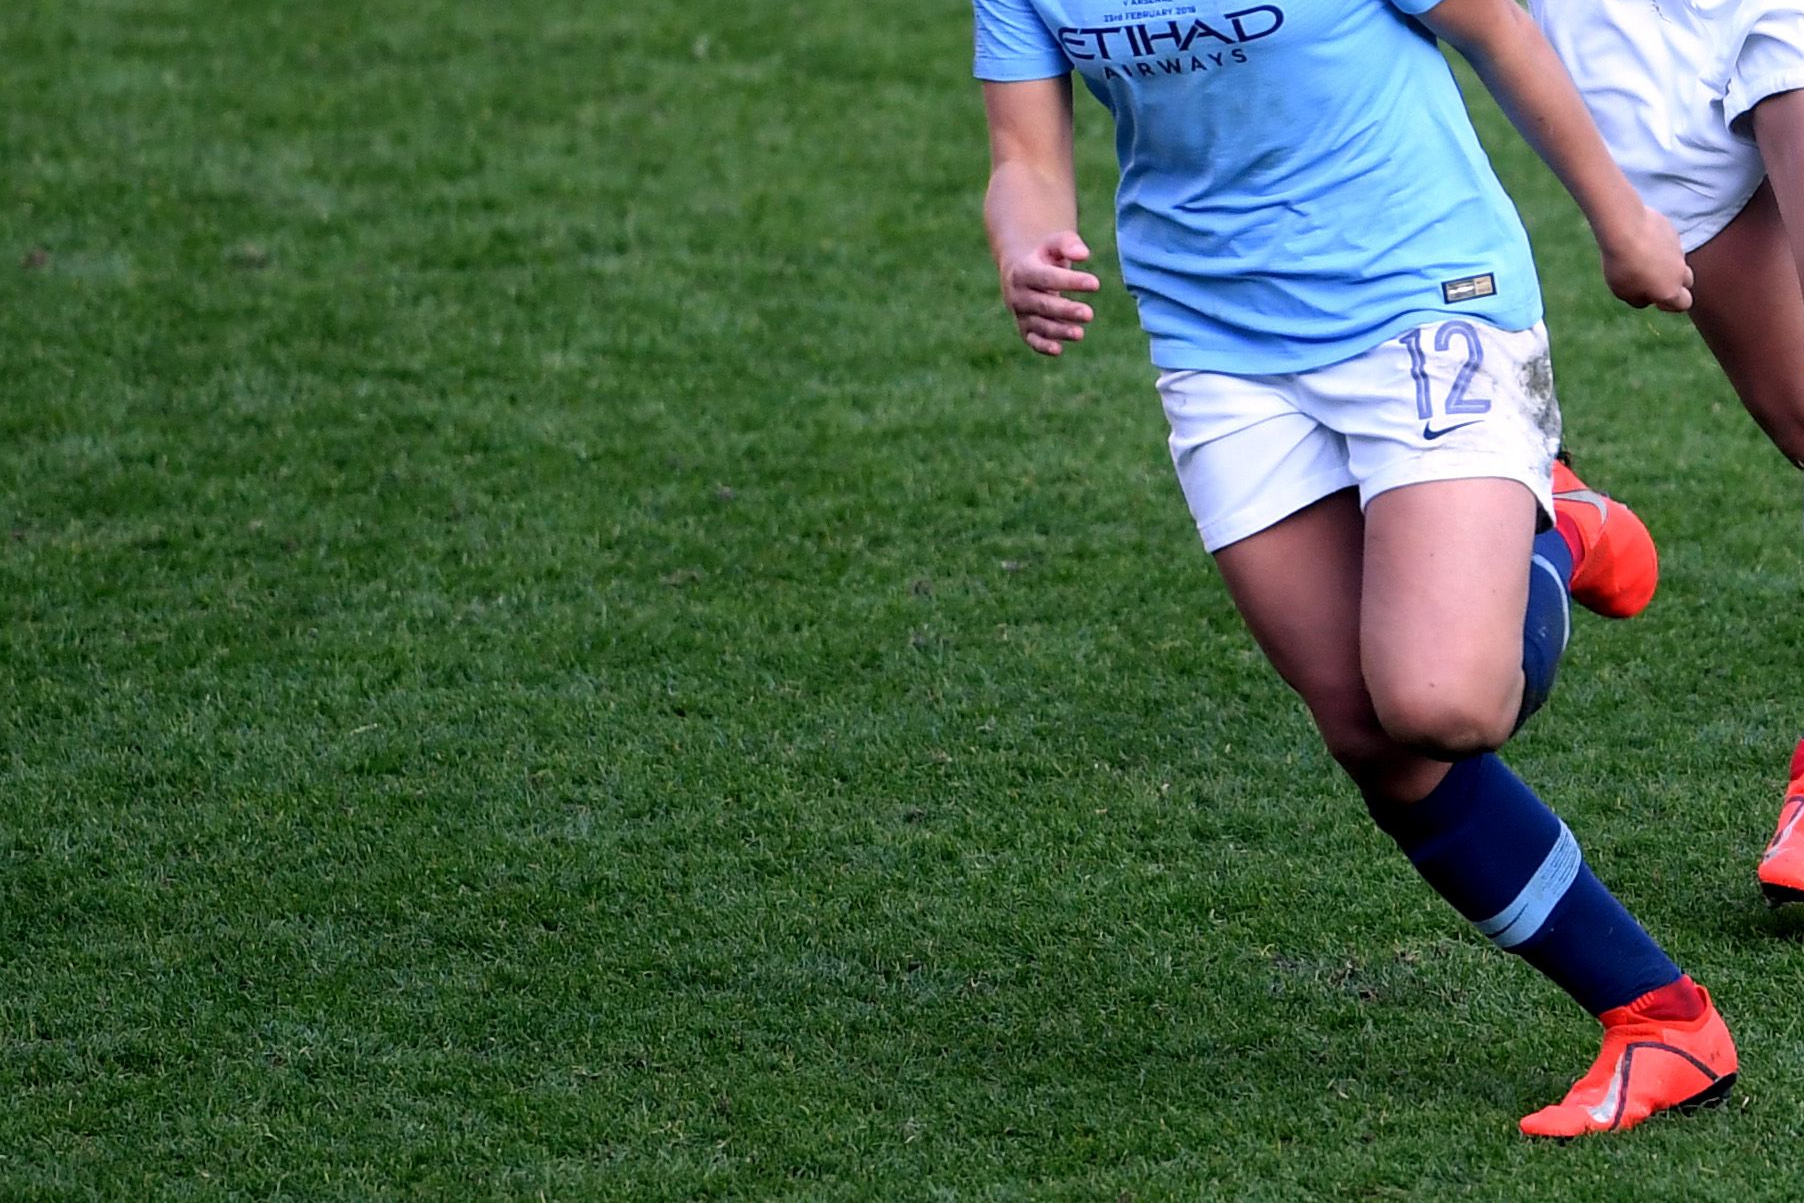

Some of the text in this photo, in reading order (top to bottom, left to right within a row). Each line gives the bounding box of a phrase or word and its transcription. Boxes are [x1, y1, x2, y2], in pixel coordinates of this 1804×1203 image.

[1058, 4, 1284, 60] ETIHAD
[1125, 8, 1173, 20] FEBRUARY
[1104, 48, 1248, 80] AIRWAYS
[1399, 320, 1492, 421] 12
